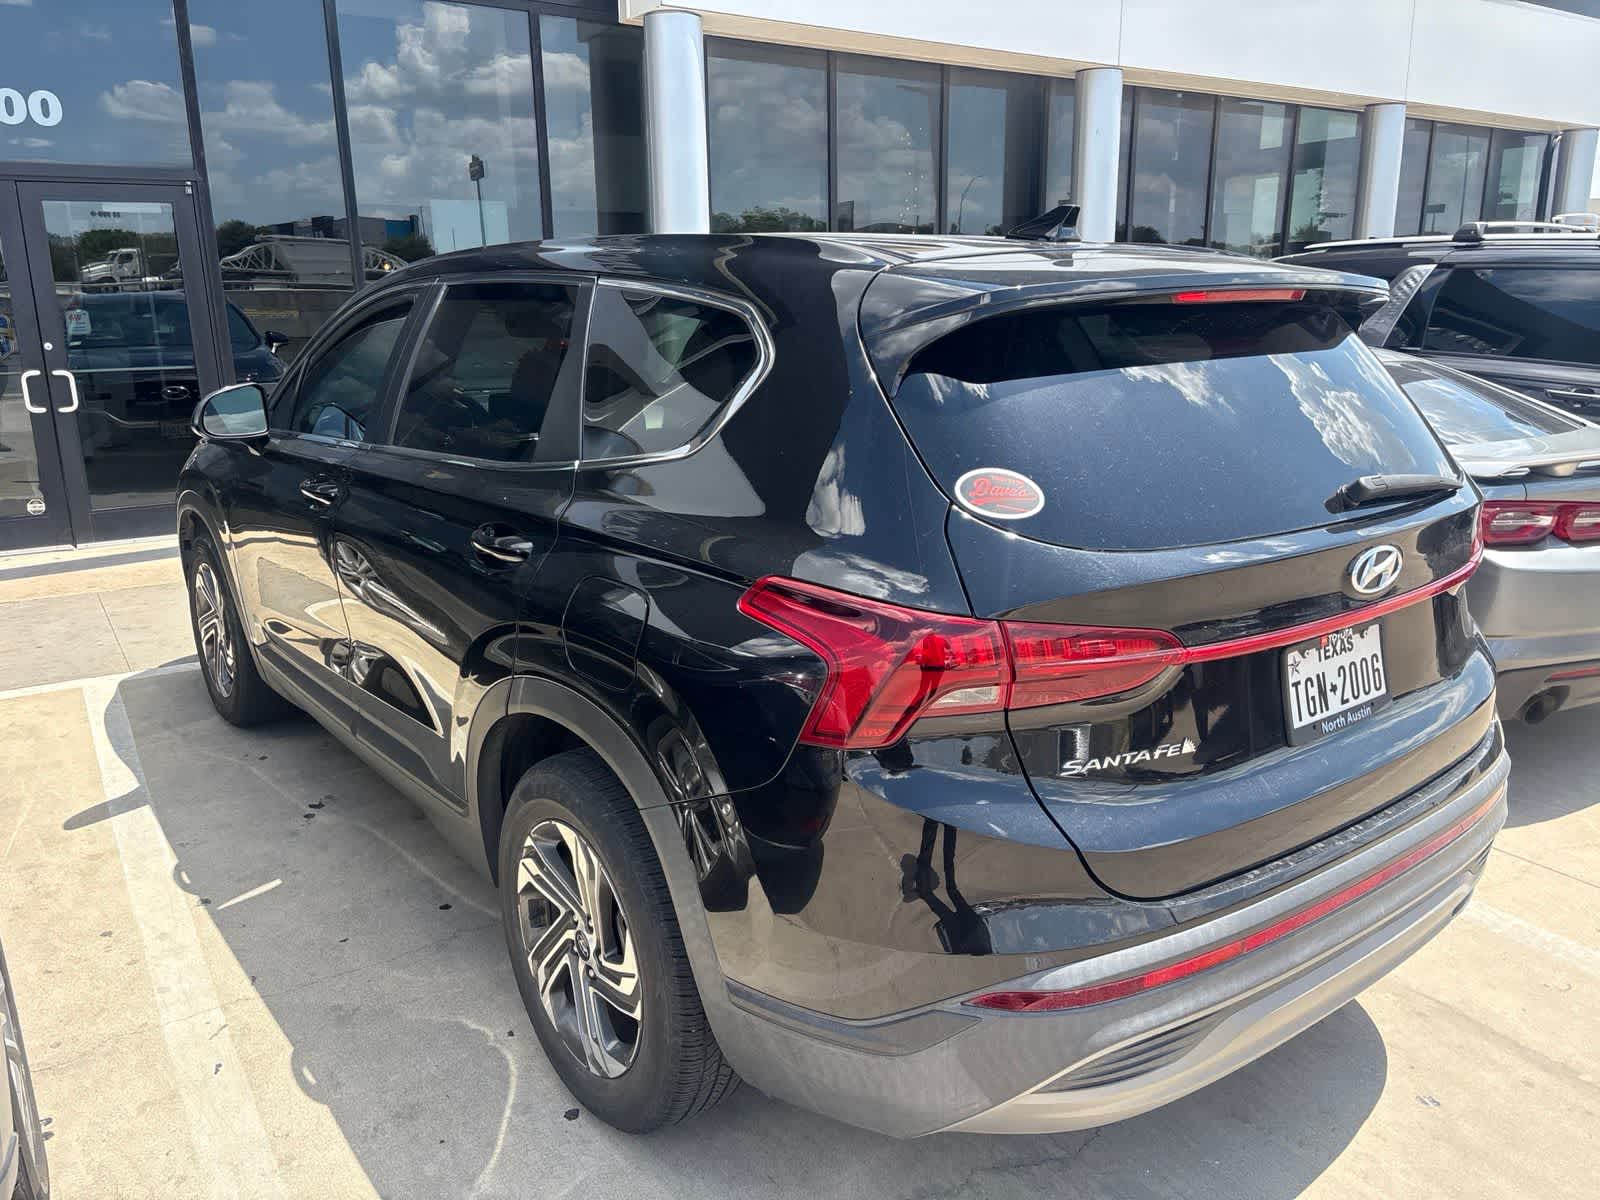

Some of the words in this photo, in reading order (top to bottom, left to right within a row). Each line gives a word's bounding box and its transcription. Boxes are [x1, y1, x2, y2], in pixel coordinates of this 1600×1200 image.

[1317, 637, 1354, 662] TEXAS
[1321, 716, 1346, 734] North
[1347, 705, 1372, 723] Austin
